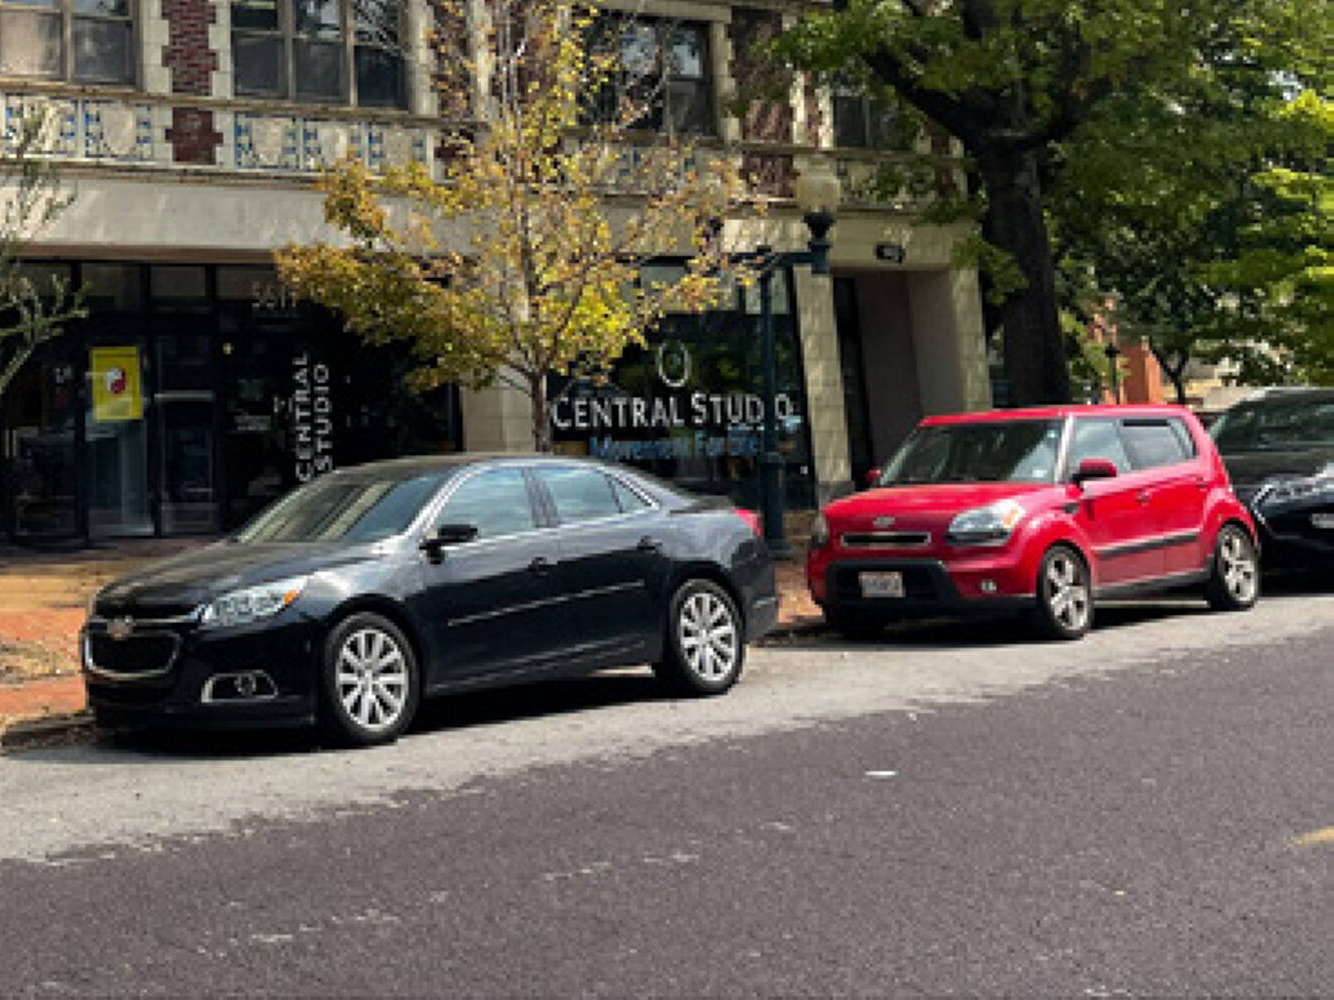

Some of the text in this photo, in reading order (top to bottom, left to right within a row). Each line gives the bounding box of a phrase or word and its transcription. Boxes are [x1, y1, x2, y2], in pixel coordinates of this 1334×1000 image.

[292, 352, 313, 481] CENTRAL
[314, 364, 332, 472] STUDIO
[552, 391, 792, 428] CENTRAL STUDO
